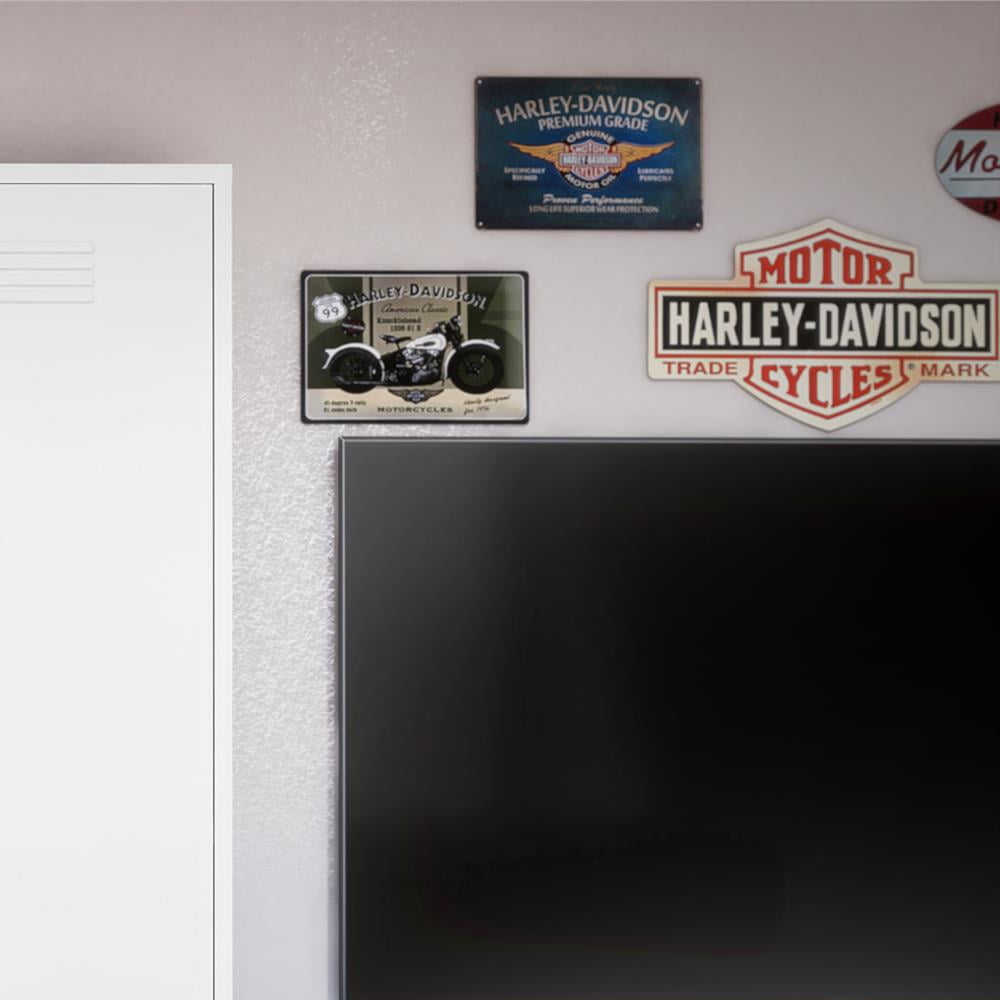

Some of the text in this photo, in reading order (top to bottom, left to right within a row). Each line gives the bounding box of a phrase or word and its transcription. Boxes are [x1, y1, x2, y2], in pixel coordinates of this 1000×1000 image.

[495, 94, 689, 126] HARLEY-DAVIDSON
[538, 115, 649, 131] PREMIUM GRADE
[566, 130, 615, 144] GENUINE
[565, 174, 600, 189] MOTOR
[758, 238, 893, 285] MOTOR
[346, 283, 487, 311] HARLEY-DAVIDSON
[322, 306, 340, 318] 99
[668, 301, 986, 348] HARLEY-DAVIDSON
[662, 361, 739, 376] TRADE
[921, 363, 990, 377] MARK
[761, 364, 893, 409] CYCLES
